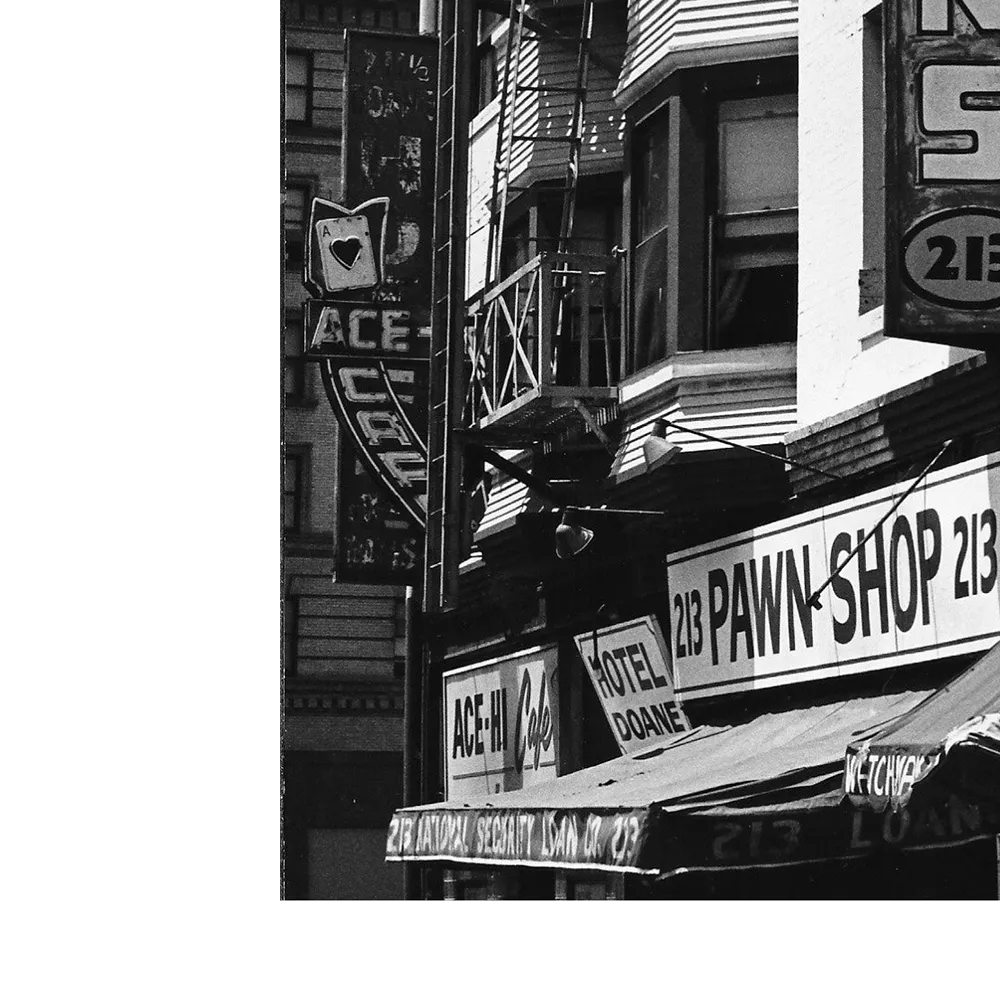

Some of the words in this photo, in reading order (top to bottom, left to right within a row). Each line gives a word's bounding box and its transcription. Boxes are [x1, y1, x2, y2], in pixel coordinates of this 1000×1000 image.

[674, 589, 702, 659] 213
[708, 545, 814, 666] PAWN
[830, 508, 942, 645] SHOP
[953, 508, 998, 600] 213
[452, 688, 507, 759] ACE-HI
[515, 668, 554, 774] Cafe
[612, 701, 686, 741] DOANE
